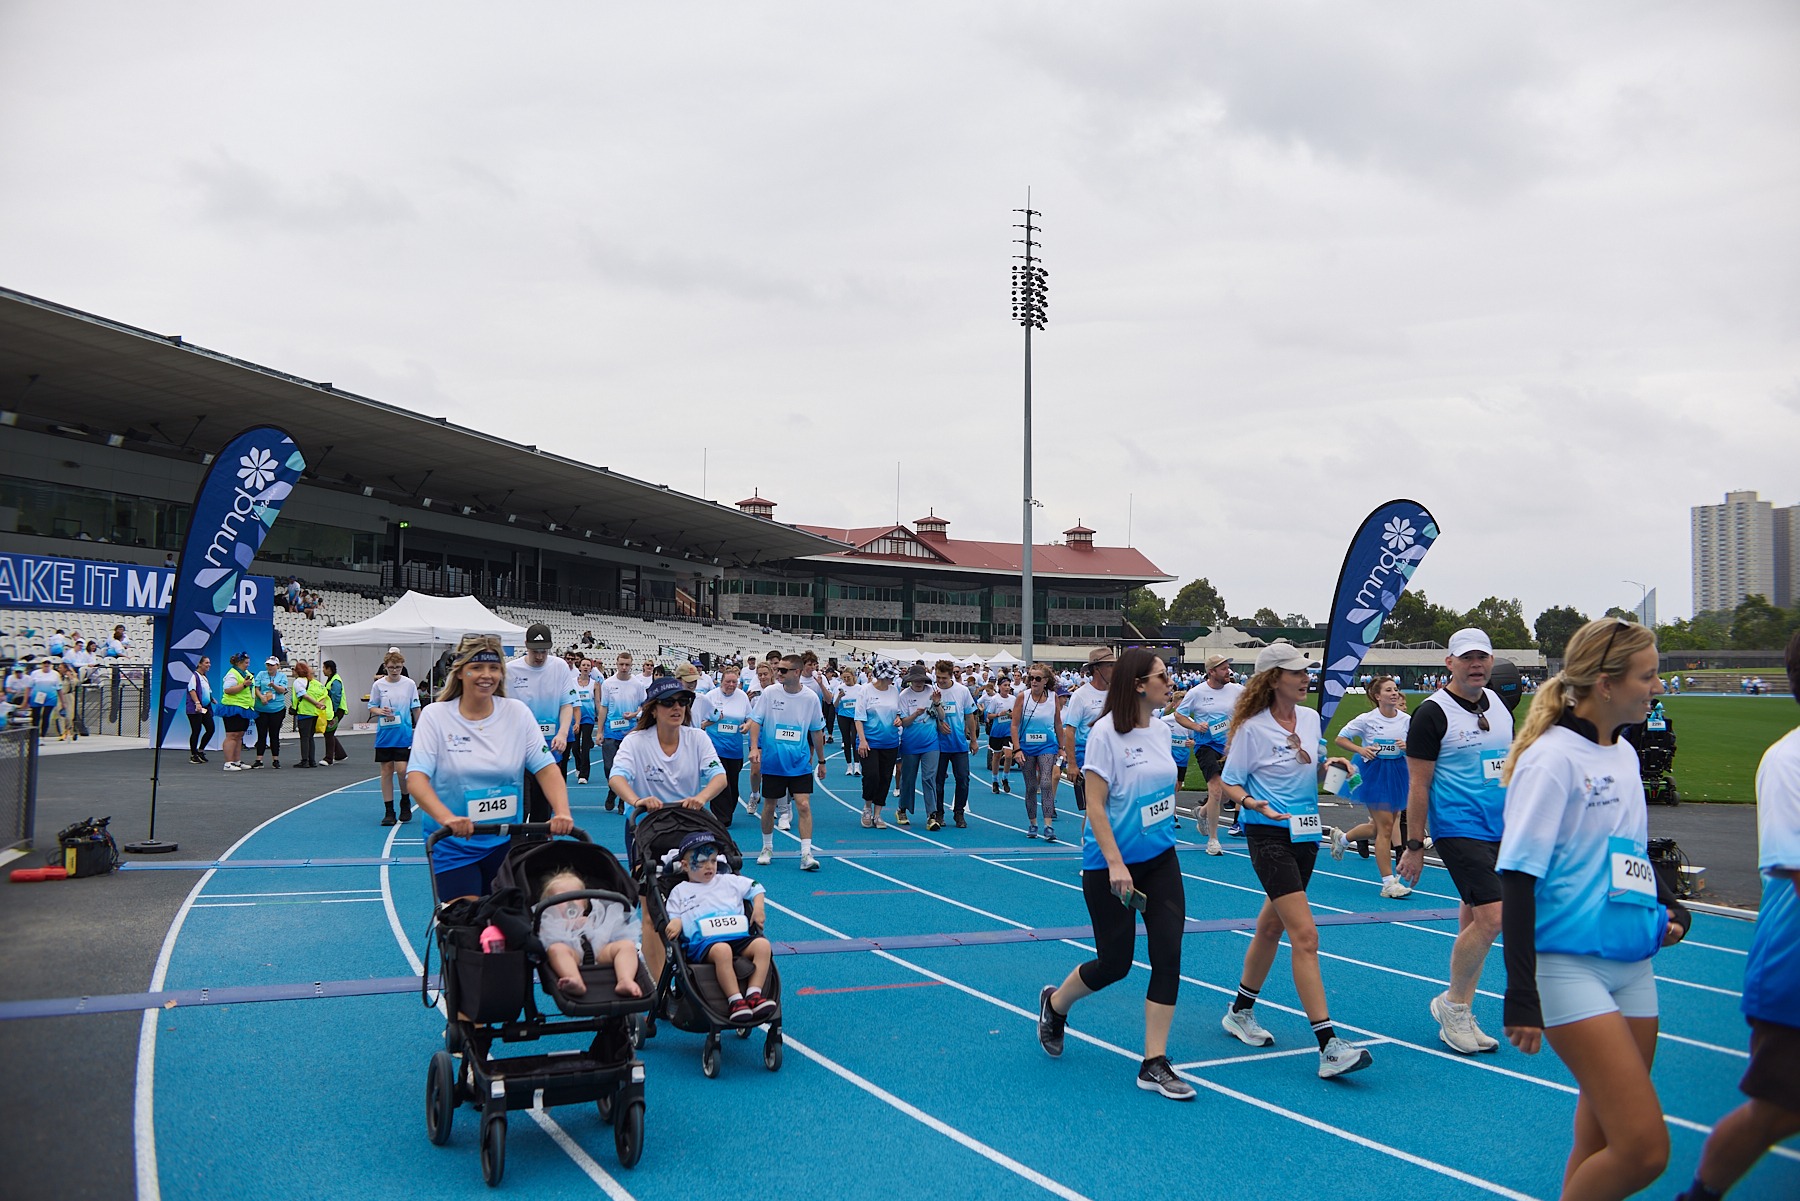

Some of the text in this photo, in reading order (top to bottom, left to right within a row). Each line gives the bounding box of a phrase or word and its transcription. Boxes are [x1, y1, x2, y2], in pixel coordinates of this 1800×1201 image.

[204, 486, 256, 567] mnd
[1355, 546, 1399, 608] mnd
[84, 565, 119, 607] IT
[126, 570, 258, 614] MAR
[781, 730, 795, 738] 2112
[1213, 721, 1227, 731] 2301
[478, 799, 507, 813] 2148
[1149, 799, 1169, 817] 1342
[1298, 816, 1318, 827] 1456
[1624, 859, 1653, 882] 2009
[708, 916, 738, 928] 1858
